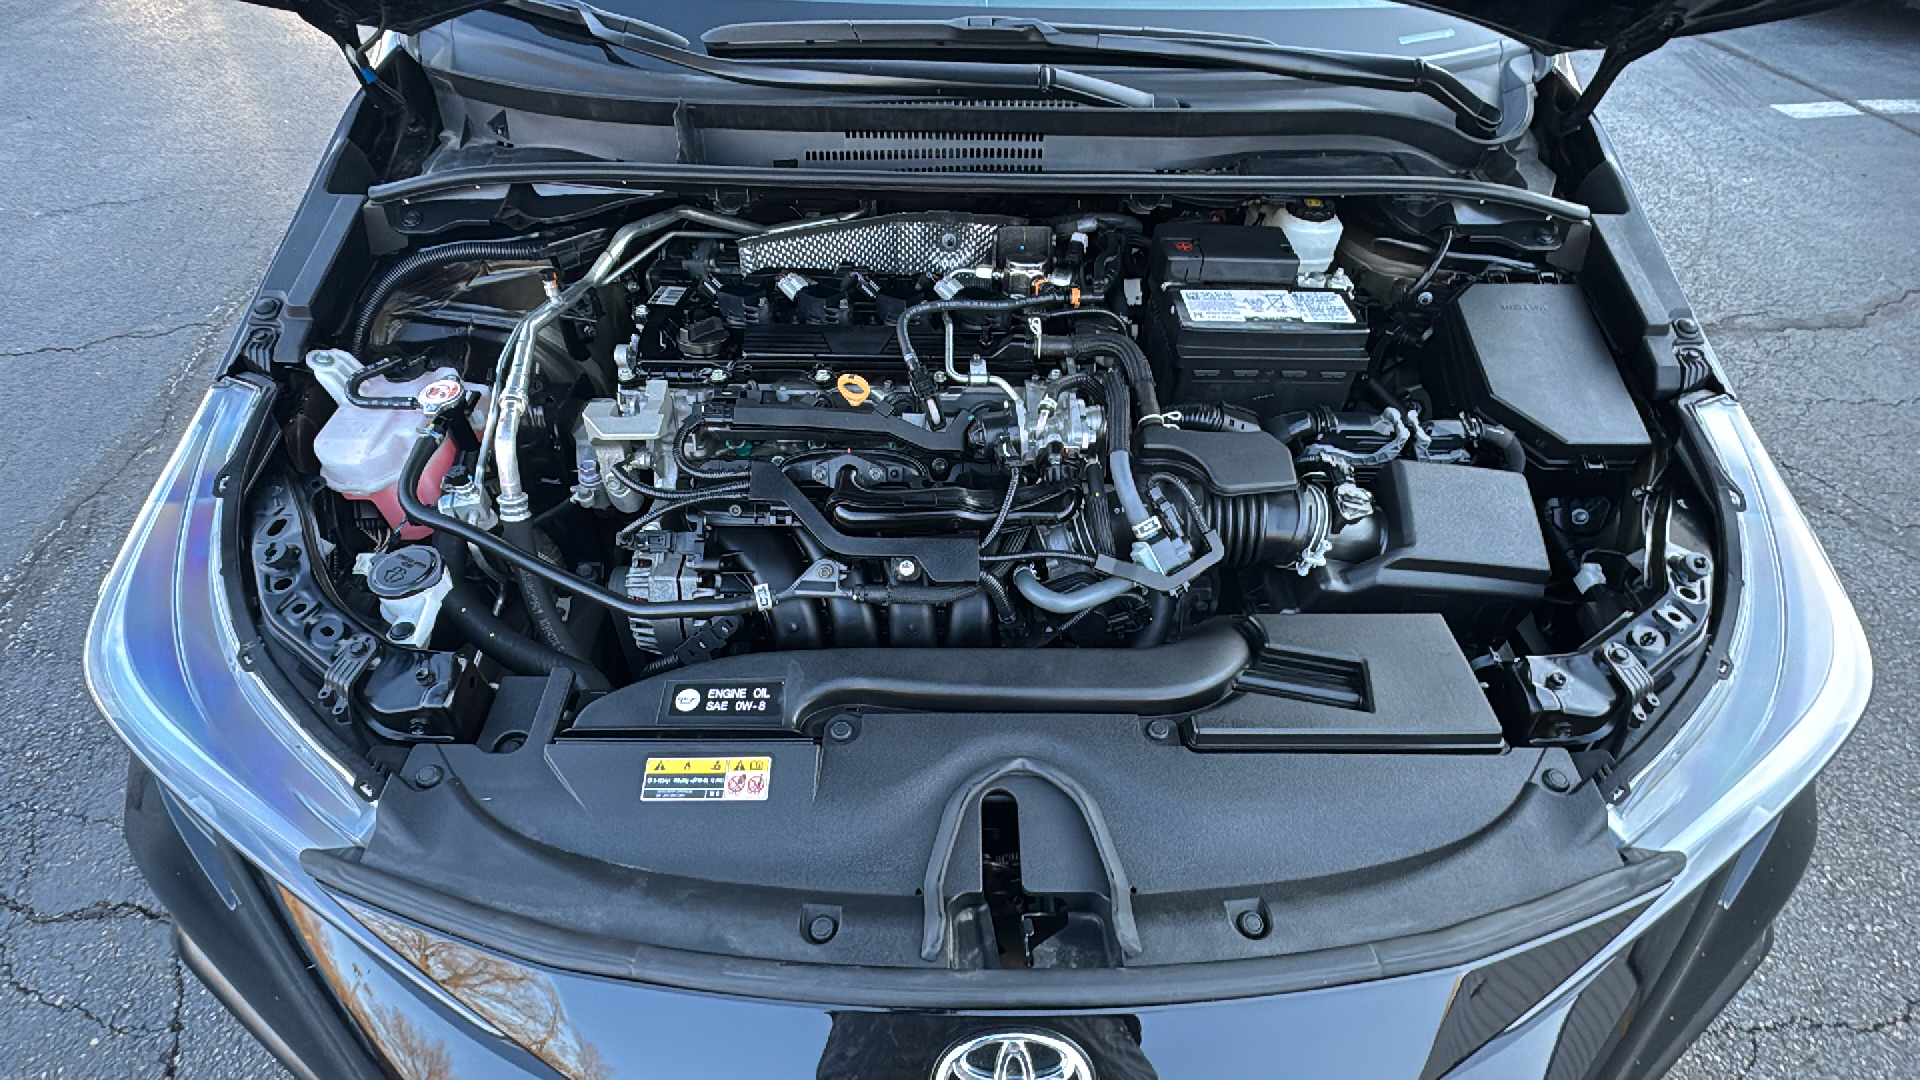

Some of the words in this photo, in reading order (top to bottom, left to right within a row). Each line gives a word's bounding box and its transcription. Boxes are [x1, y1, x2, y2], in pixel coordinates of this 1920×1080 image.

[707, 688, 747, 699] ENGINE
[753, 688, 771, 699] OIL
[705, 701, 729, 711] SAE
[735, 701, 767, 711] 0W-8
